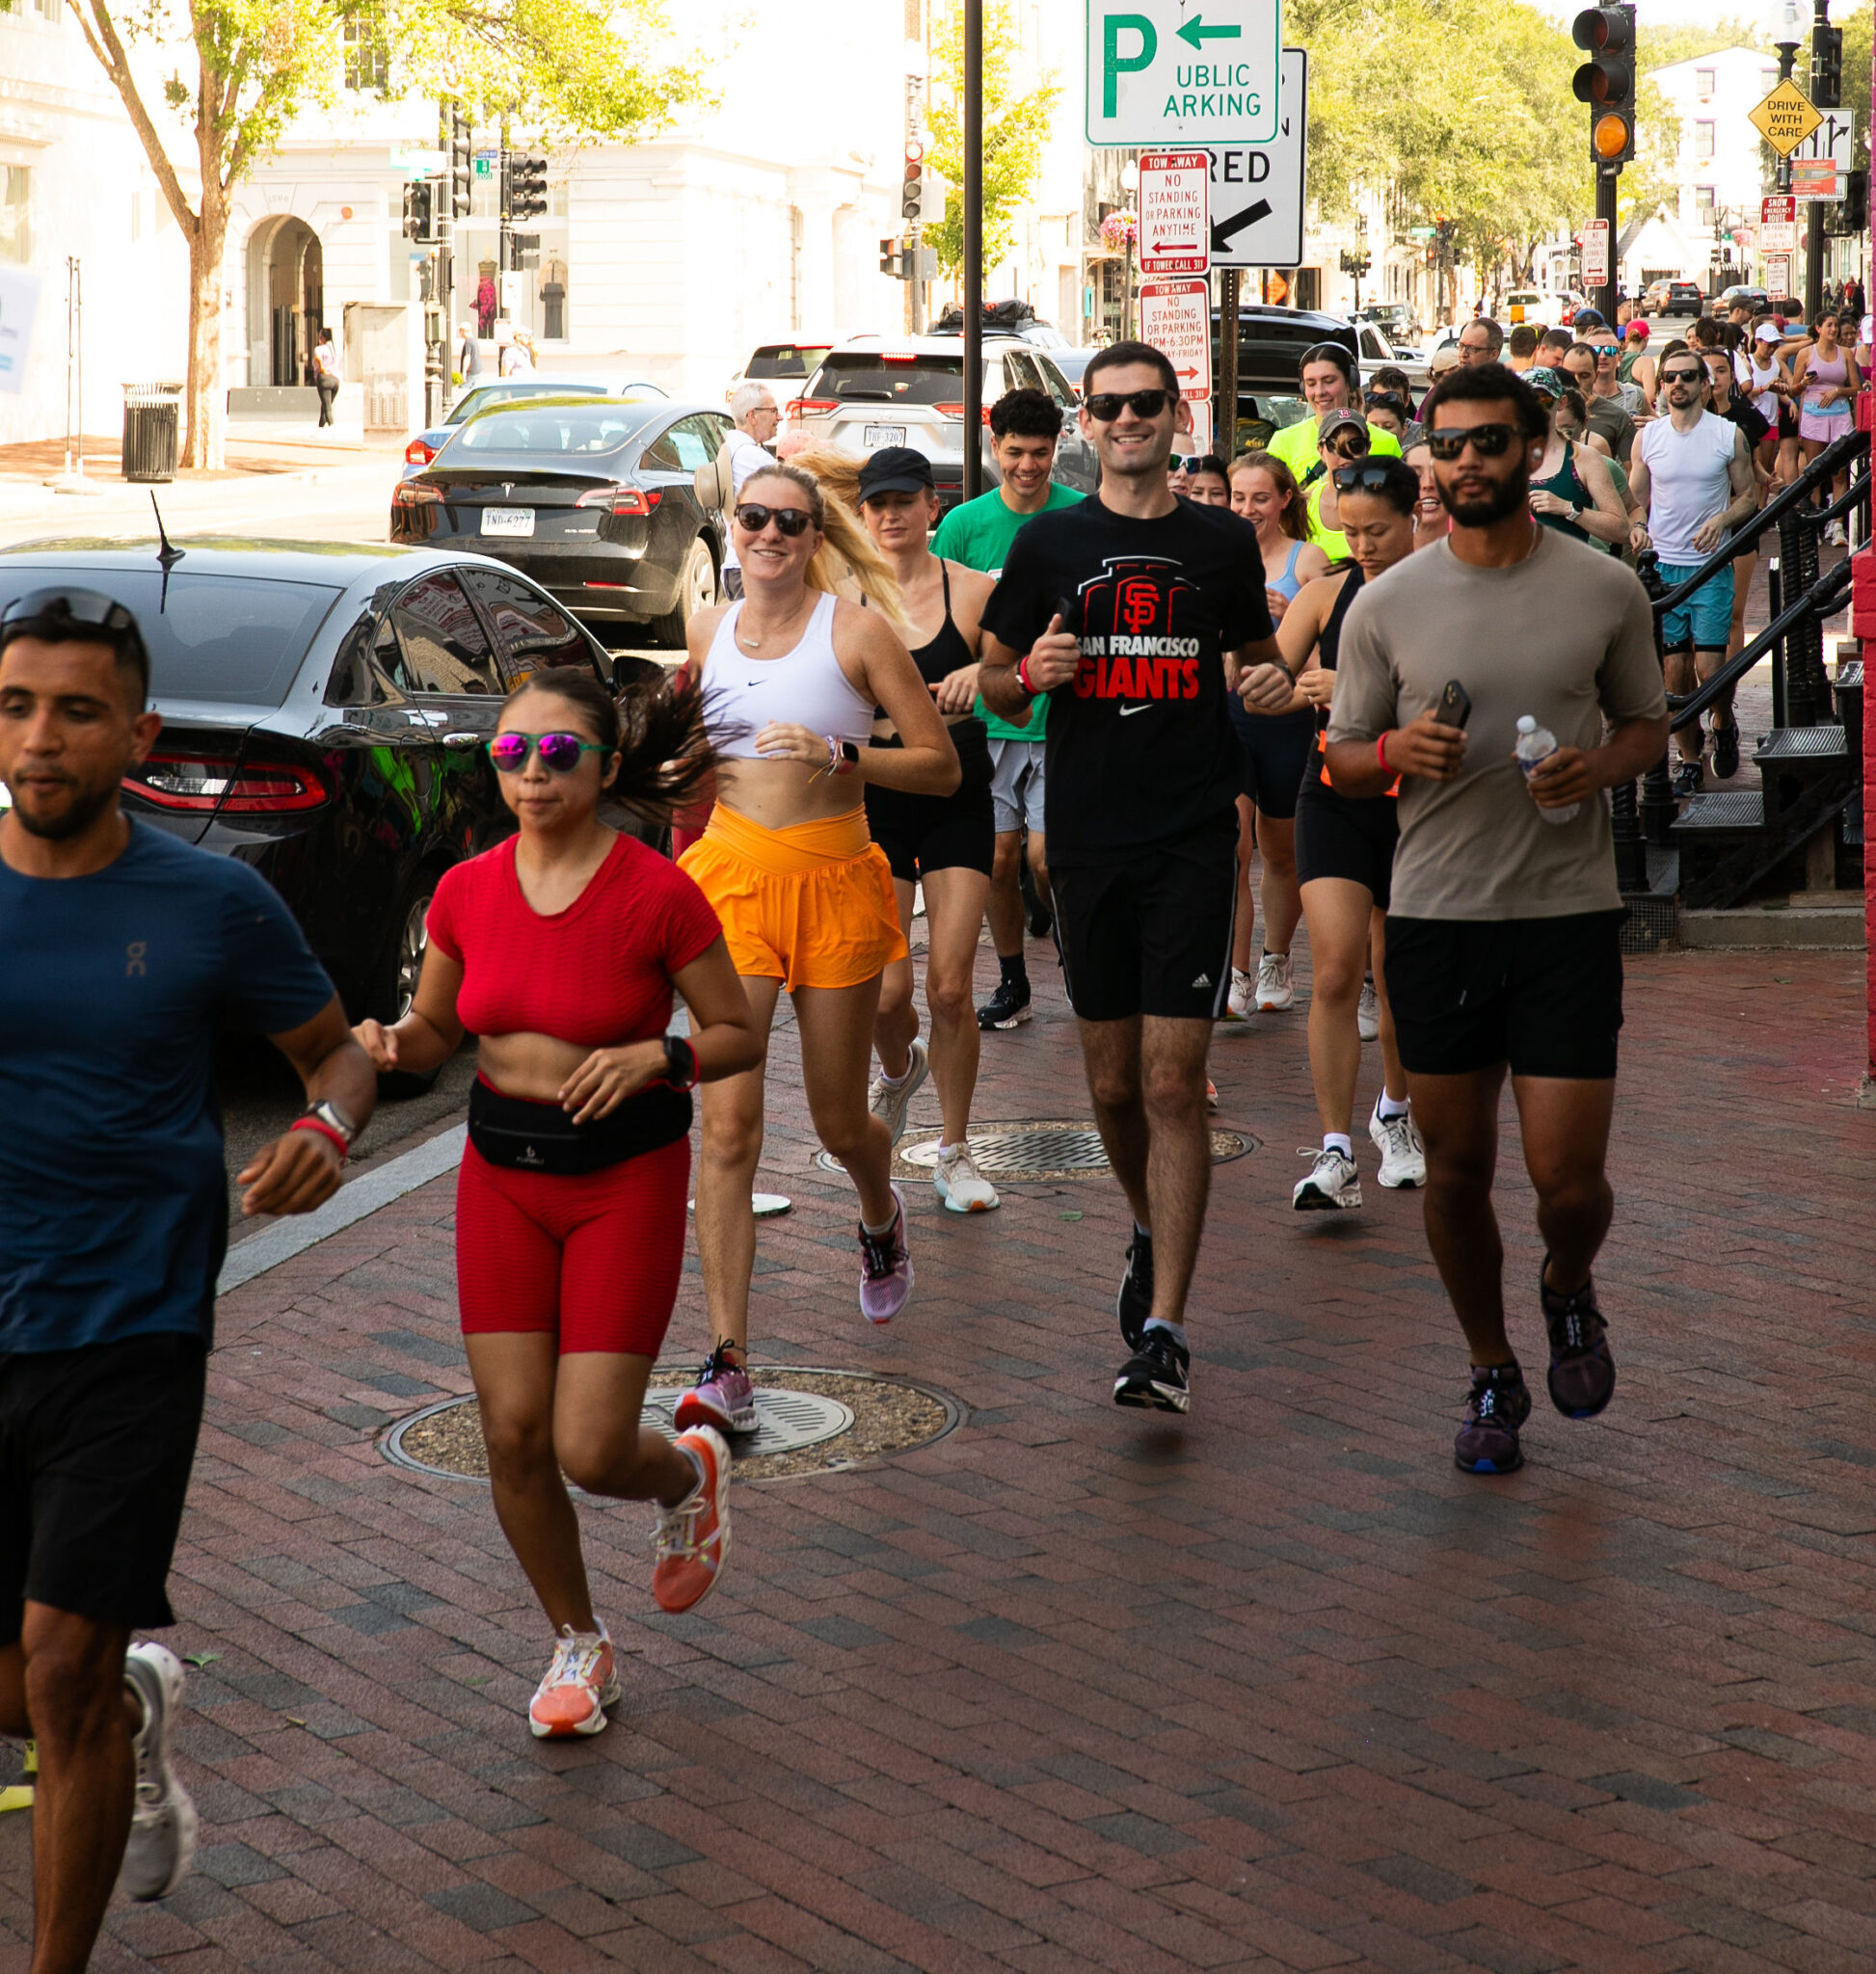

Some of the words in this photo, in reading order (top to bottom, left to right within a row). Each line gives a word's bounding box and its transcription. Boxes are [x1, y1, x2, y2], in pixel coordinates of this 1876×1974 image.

[1103, 14, 1158, 119] P
[1176, 64, 1249, 88] UBLIC
[1163, 93, 1261, 118] ARKING
[1767, 100, 1806, 112] DRIVE
[1770, 114, 1803, 124] WITH
[1767, 126, 1804, 138] CARE
[1148, 157, 1167, 170] TOW
[1171, 156, 1197, 169] AWAY
[1165, 173, 1181, 187] NO
[1148, 190, 1198, 204] STANDING
[1767, 198, 1788, 208] SNOW
[1145, 210, 1155, 221] OR
[1156, 206, 1201, 221] PARKING
[1767, 214, 1786, 223] ROUTE
[1152, 223, 1196, 237] ANYTIME
[1144, 260, 1150, 271] IF
[1174, 258, 1192, 270] CALL
[1193, 258, 1204, 270] 311
[1155, 285, 1169, 296] TOW
[1170, 283, 1192, 295] AWAY
[1166, 296, 1180, 307] NO
[1151, 308, 1196, 322] STANDING
[1147, 324, 1160, 335] OR
[1162, 321, 1202, 334] PARKING
[1194, 388, 1204, 399] 311
[1110, 635, 1200, 657] FRANCISCO
[1072, 656, 1200, 700] GIANTS
